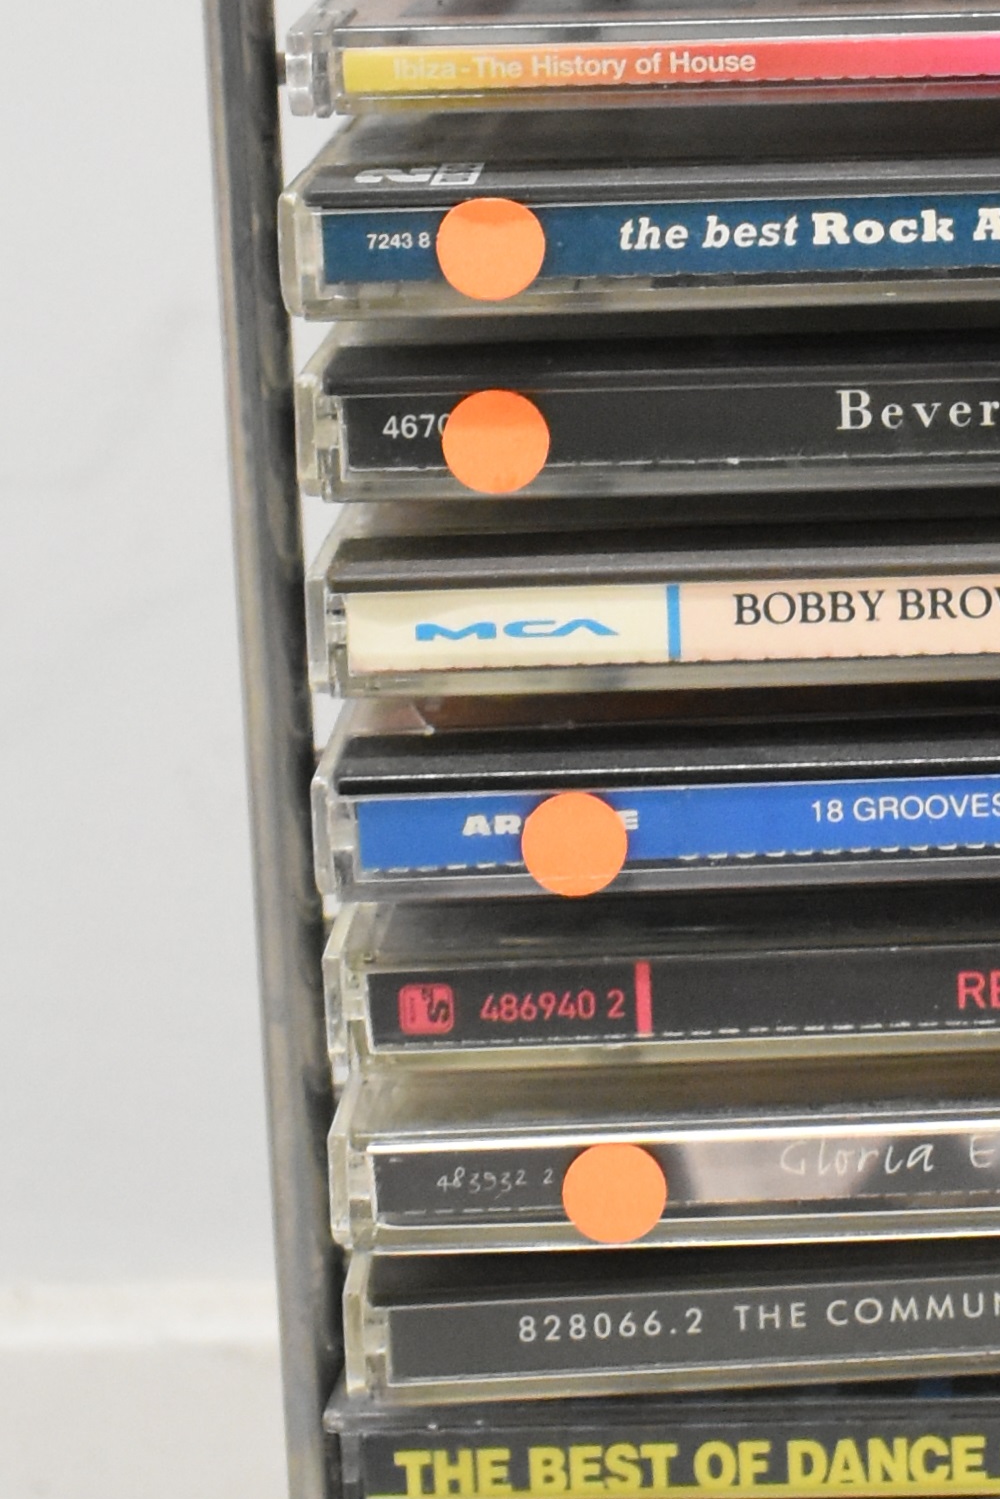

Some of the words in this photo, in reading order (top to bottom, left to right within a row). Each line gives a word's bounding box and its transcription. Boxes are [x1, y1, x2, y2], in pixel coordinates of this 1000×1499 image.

[471, 51, 523, 78] The
[529, 51, 628, 83] History
[634, 50, 662, 74] of
[669, 49, 757, 73] House
[620, 215, 689, 251] the
[702, 214, 800, 249] best
[811, 211, 954, 245] Rock
[733, 590, 886, 627] BOBBY
[811, 801, 846, 824] 18
[479, 991, 597, 1024] 486940
[780, 1133, 937, 1177] Gloria
[518, 1309, 705, 1344] 828066.2
[734, 1301, 807, 1331] THE
[394, 1449, 511, 1499] THE
[528, 1442, 680, 1493] BEST
[692, 1439, 771, 1490] OF
[786, 1435, 987, 1486] DANCE
